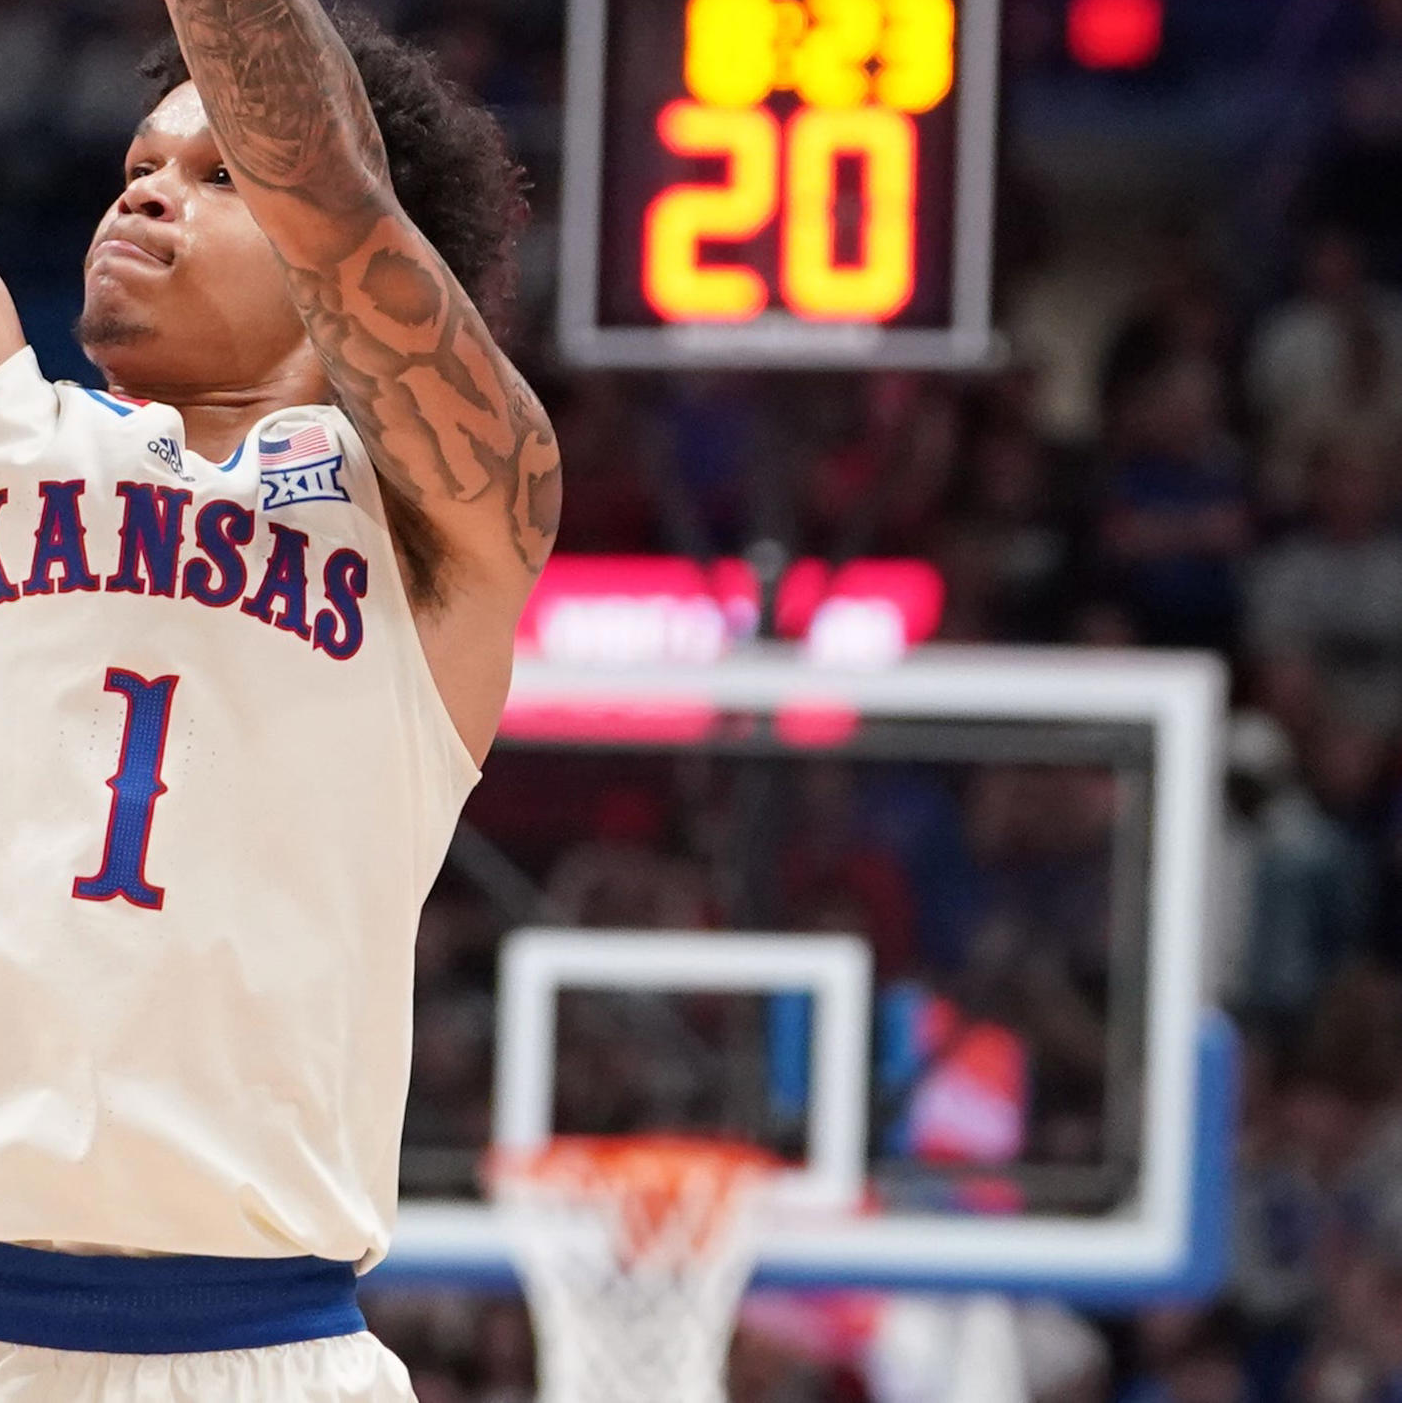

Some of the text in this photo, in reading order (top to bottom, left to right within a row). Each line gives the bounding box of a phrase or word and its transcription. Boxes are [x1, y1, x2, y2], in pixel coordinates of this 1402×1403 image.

[644, 99, 917, 322] 20
[147, 440, 196, 482] adid
[71, 667, 180, 911] 1
